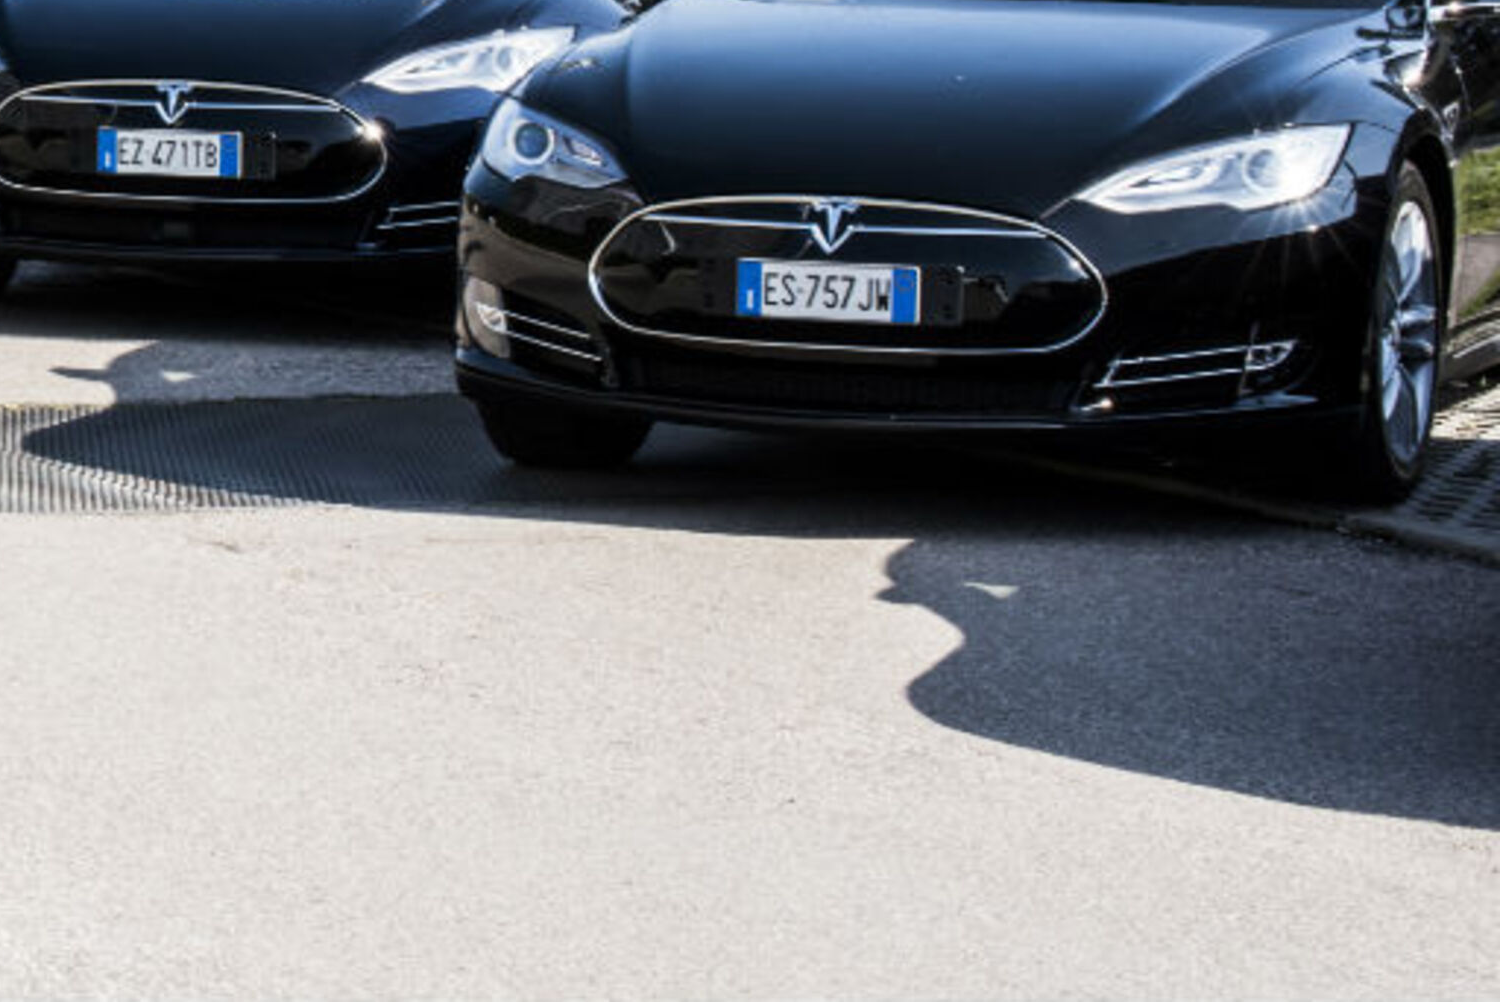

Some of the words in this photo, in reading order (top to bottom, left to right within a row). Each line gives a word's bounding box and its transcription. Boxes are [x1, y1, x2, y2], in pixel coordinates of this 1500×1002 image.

[118, 137, 144, 166] EZ
[151, 139, 218, 169] 471TB
[764, 271, 797, 307] ES
[805, 274, 892, 312] 757JW
